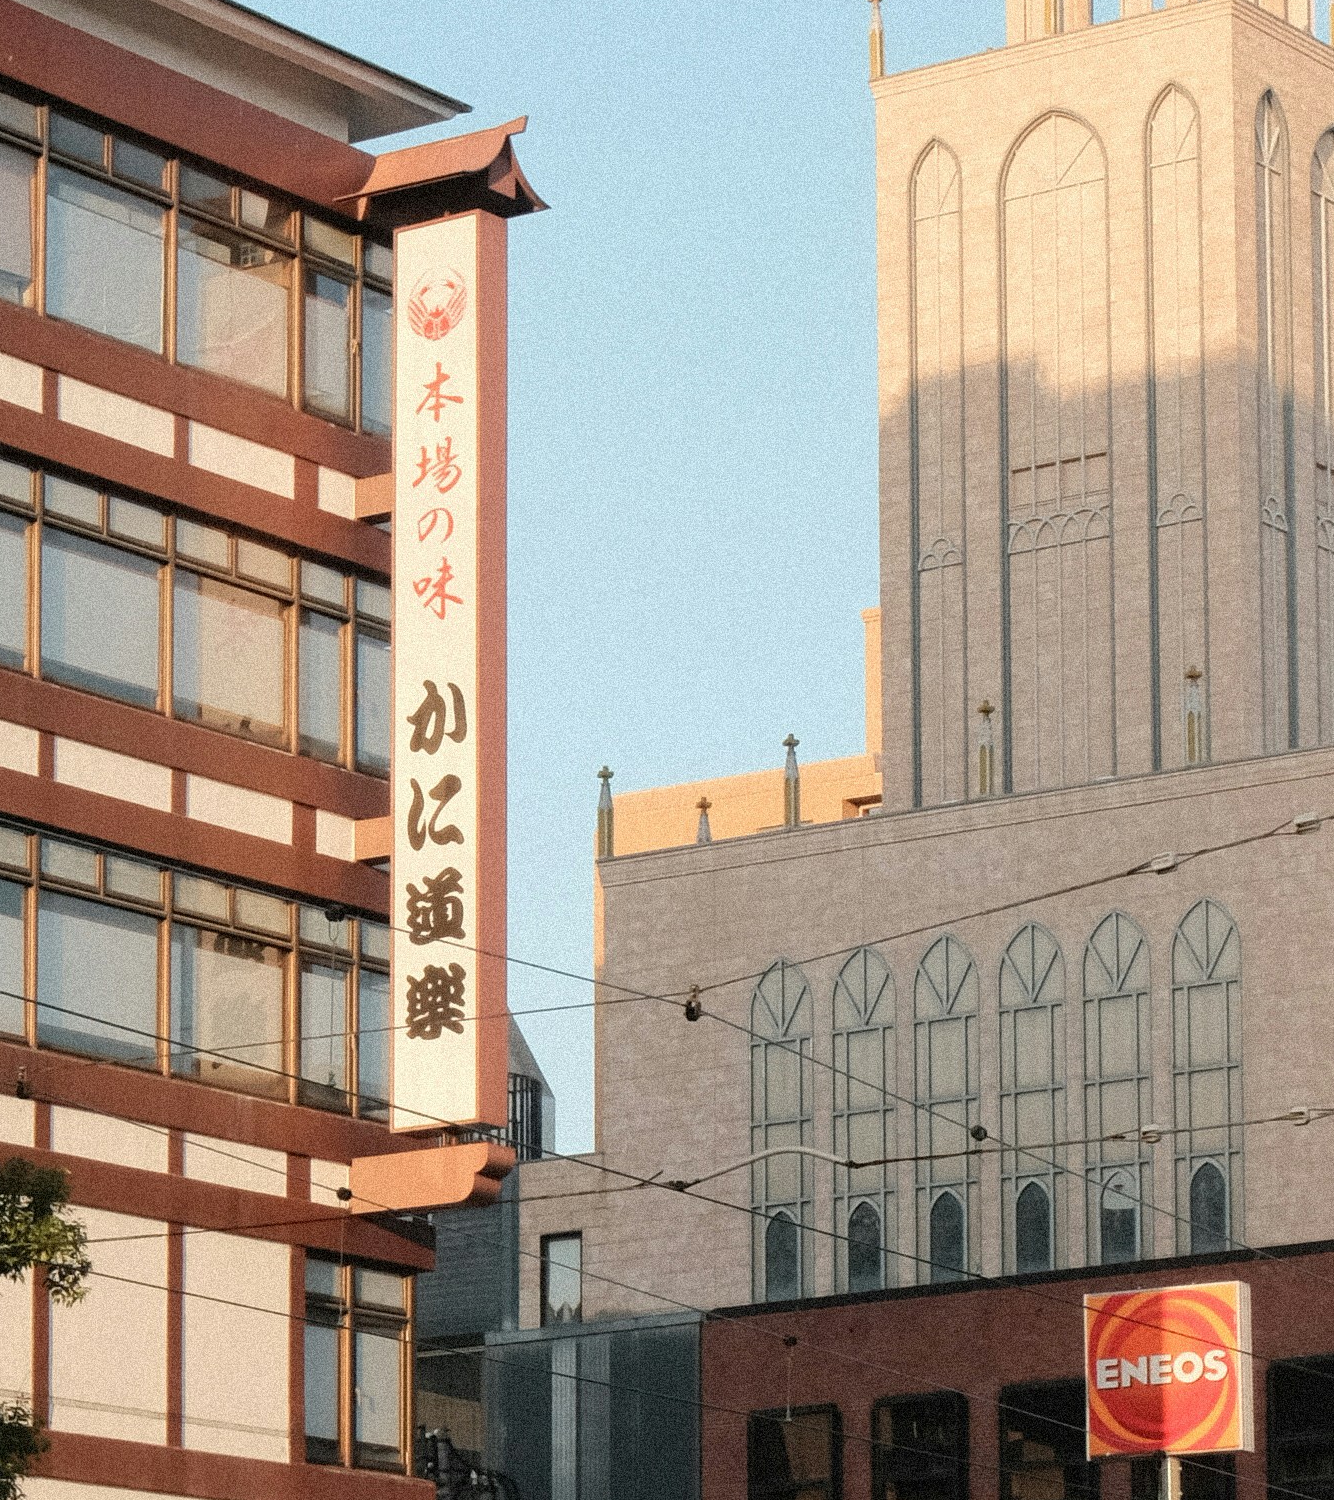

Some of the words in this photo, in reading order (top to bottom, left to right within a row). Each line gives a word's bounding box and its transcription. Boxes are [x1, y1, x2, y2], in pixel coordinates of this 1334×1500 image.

[411, 360, 465, 622] 本場の味
[1096, 1349, 1228, 1390] ENEOS
